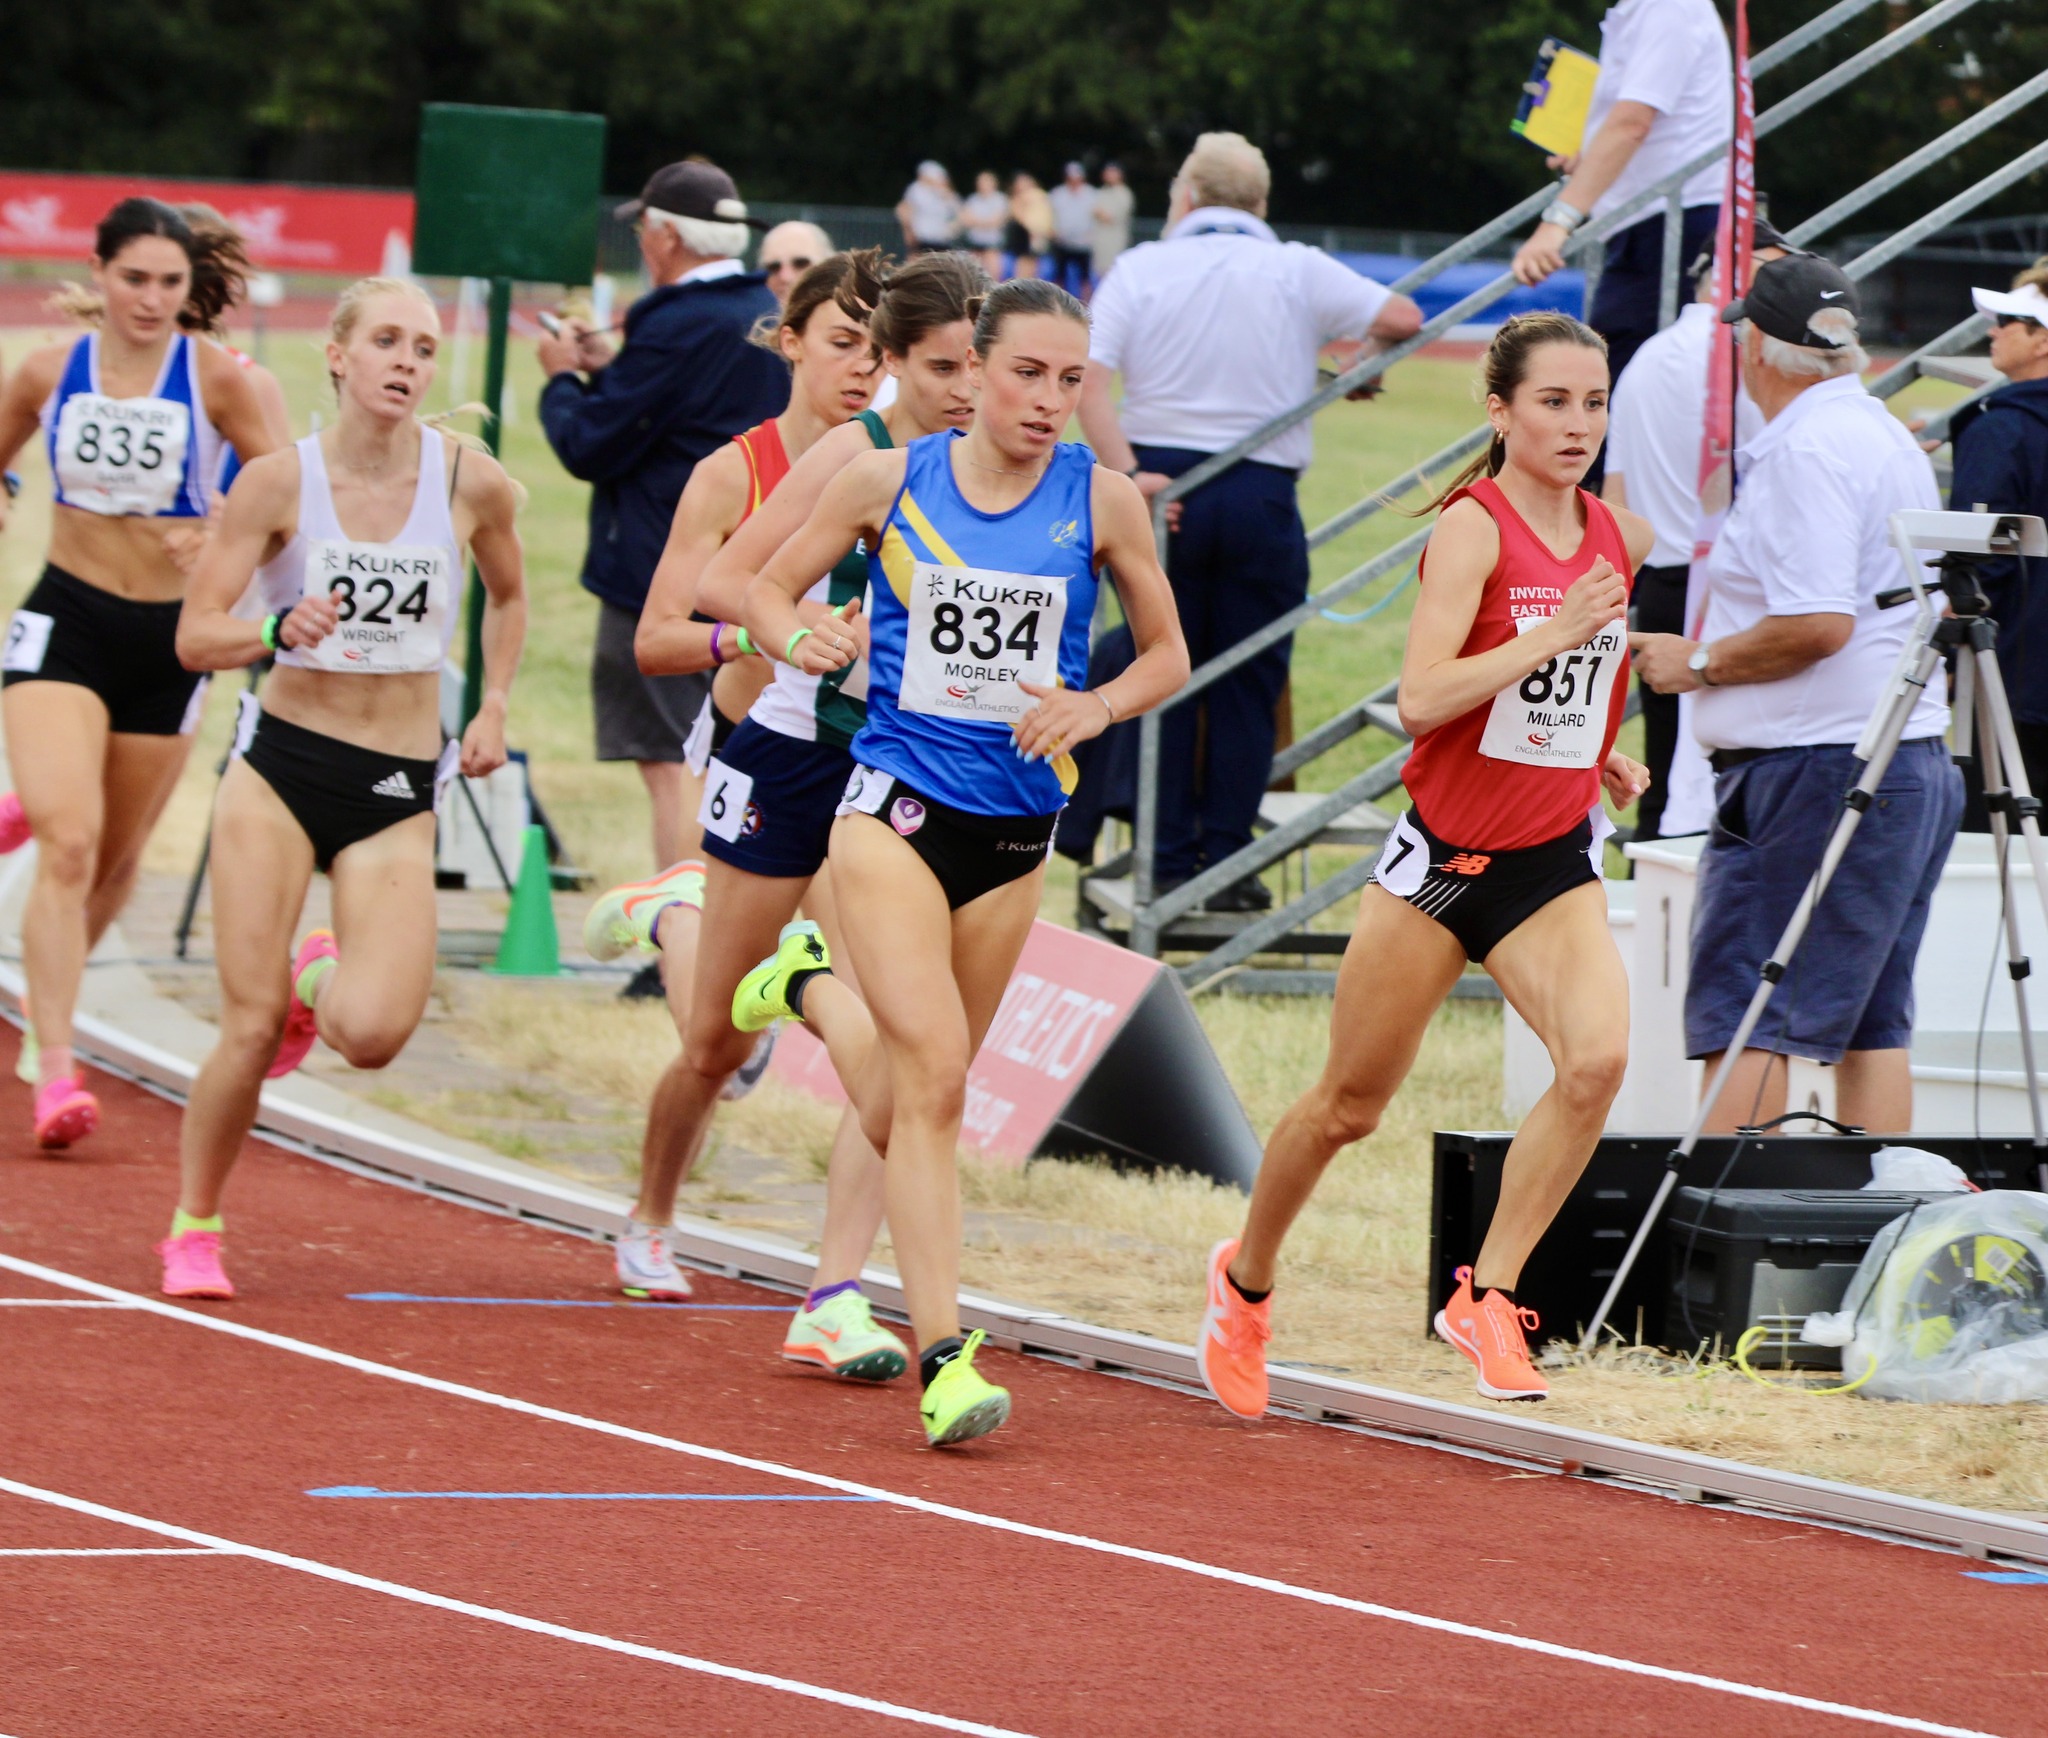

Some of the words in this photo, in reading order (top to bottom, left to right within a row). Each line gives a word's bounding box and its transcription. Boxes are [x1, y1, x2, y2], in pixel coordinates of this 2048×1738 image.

[95, 403, 173, 425] KUKRI
[76, 423, 164, 469] 835
[347, 552, 438, 575] KUKRI
[329, 575, 429, 624] 824
[953, 578, 1053, 607] KUKRI
[1509, 586, 1564, 600] INVICTA
[1510, 604, 1546, 617] EAST
[342, 628, 407, 643] WRIGHT
[930, 602, 1040, 661] 834
[1573, 635, 1618, 652] KRI
[944, 662, 1020, 682] MORLEY
[1519, 655, 1603, 706] 851
[935, 698, 973, 710] ENGLAND
[978, 702, 1020, 714] ATHLETICS
[1526, 710, 1586, 727] MILLARD
[1514, 745, 1548, 757] ENGLAND
[1550, 750, 1582, 758] ATHLETICS
[711, 780, 729, 820] 6
[1385, 834, 1415, 875] 7
